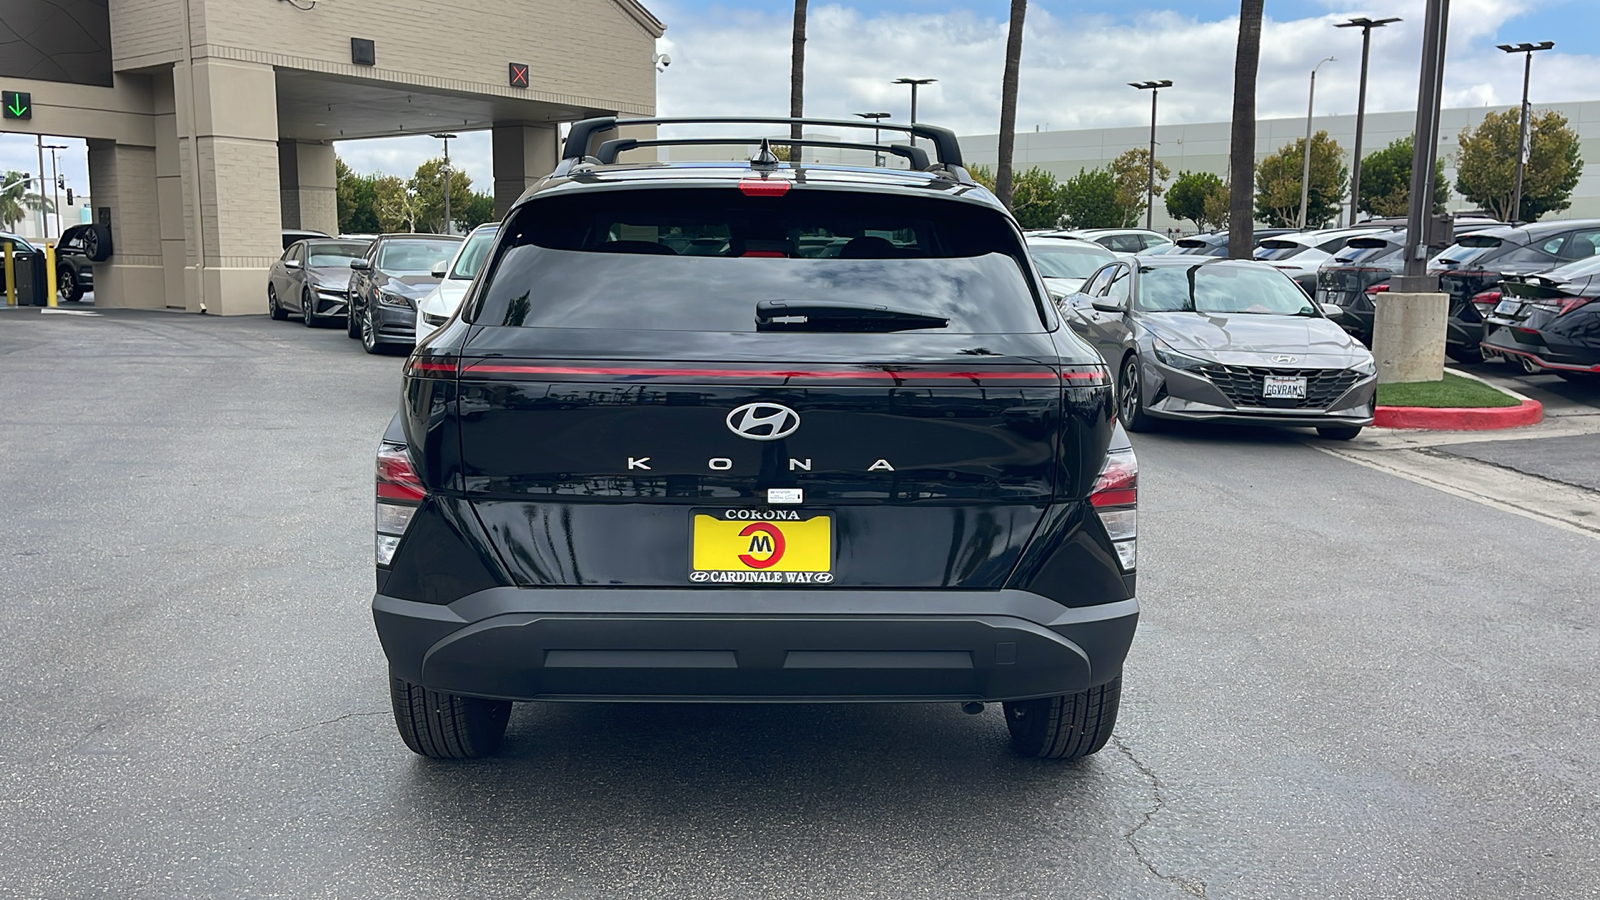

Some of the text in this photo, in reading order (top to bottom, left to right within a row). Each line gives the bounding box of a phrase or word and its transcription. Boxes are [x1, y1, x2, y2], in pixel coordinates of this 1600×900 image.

[1266, 384, 1303, 395] GGVRAMS
[628, 457, 895, 472] KONA
[725, 509, 800, 520] CORONA
[710, 571, 814, 583] CARDINALE WAY
